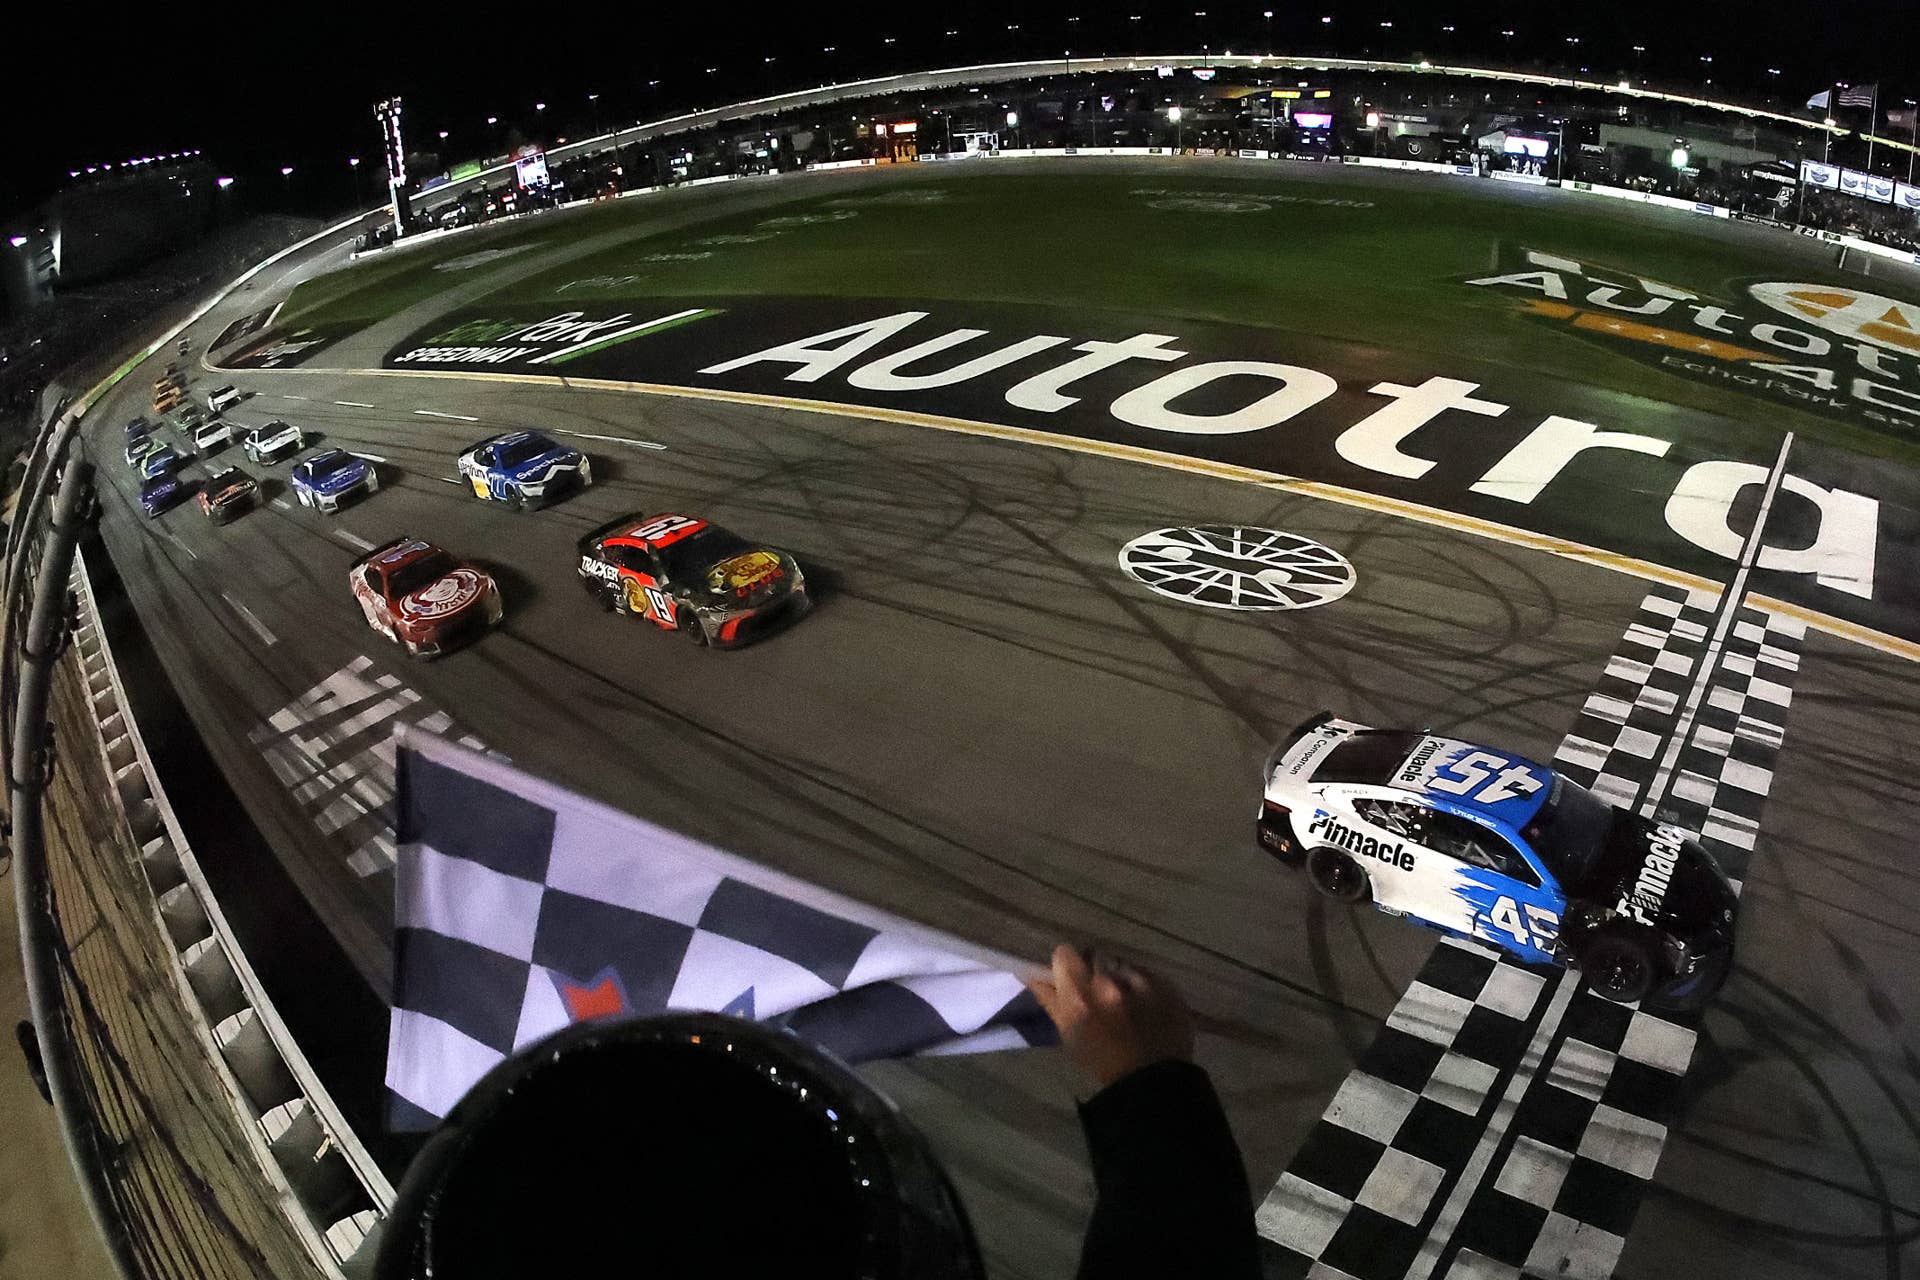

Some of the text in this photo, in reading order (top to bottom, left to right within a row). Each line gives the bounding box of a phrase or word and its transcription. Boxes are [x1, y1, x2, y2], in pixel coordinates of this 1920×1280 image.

[393, 347, 543, 364] SPEEDWAY
[581, 555, 619, 582] TRACKER
[644, 586, 674, 622] 19
[1400, 738, 1446, 782] Pinnacle
[1426, 751, 1544, 804] 45
[1308, 808, 1415, 872] Pinnacle
[1615, 821, 1686, 927] Pinnacle
[1490, 895, 1560, 956] 45
